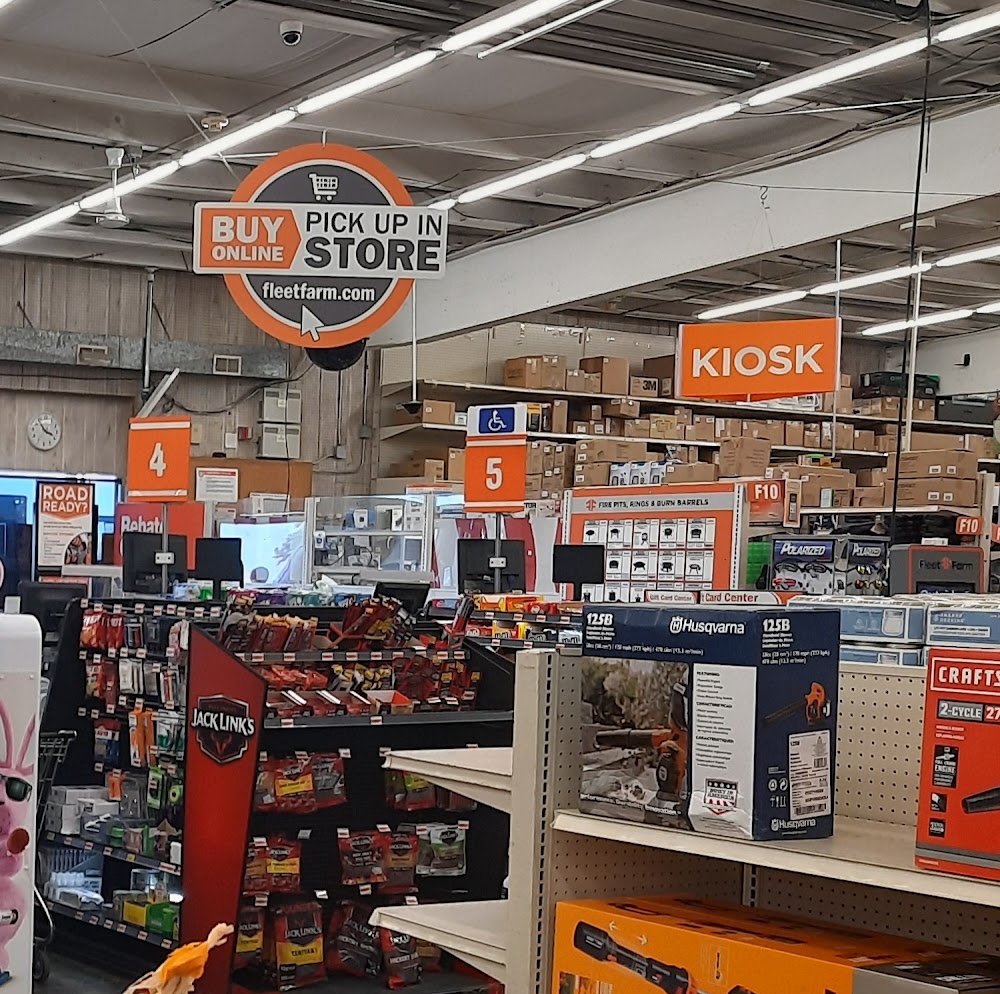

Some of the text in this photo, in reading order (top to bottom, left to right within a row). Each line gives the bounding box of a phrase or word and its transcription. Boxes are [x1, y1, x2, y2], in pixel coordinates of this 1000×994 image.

[305, 211, 442, 236] PICK UP IN
[211, 215, 284, 262] BUY ONLINE
[303, 236, 442, 272] STORE
[261, 281, 375, 301] fleetfarm.com
[691, 343, 824, 379] KIOSK
[642, 379, 657, 392] 3M
[149, 442, 167, 478] 4
[484, 457, 503, 490] 5
[42, 485, 89, 500] ROAD
[754, 484, 779, 500] F10
[42, 501, 89, 513] READY?
[677, 498, 709, 507] BARRELS
[121, 514, 164, 535] Rebat
[959, 518, 979, 533] F10
[779, 543, 827, 556] POLARIZED
[705, 592, 759, 603] Card Center
[586, 612, 614, 626] 125B
[682, 618, 746, 635] Husqvarna
[762, 618, 791, 632] 125B
[191, 707, 219, 731] JACK
[939, 702, 983, 719] 2-CYCLE
